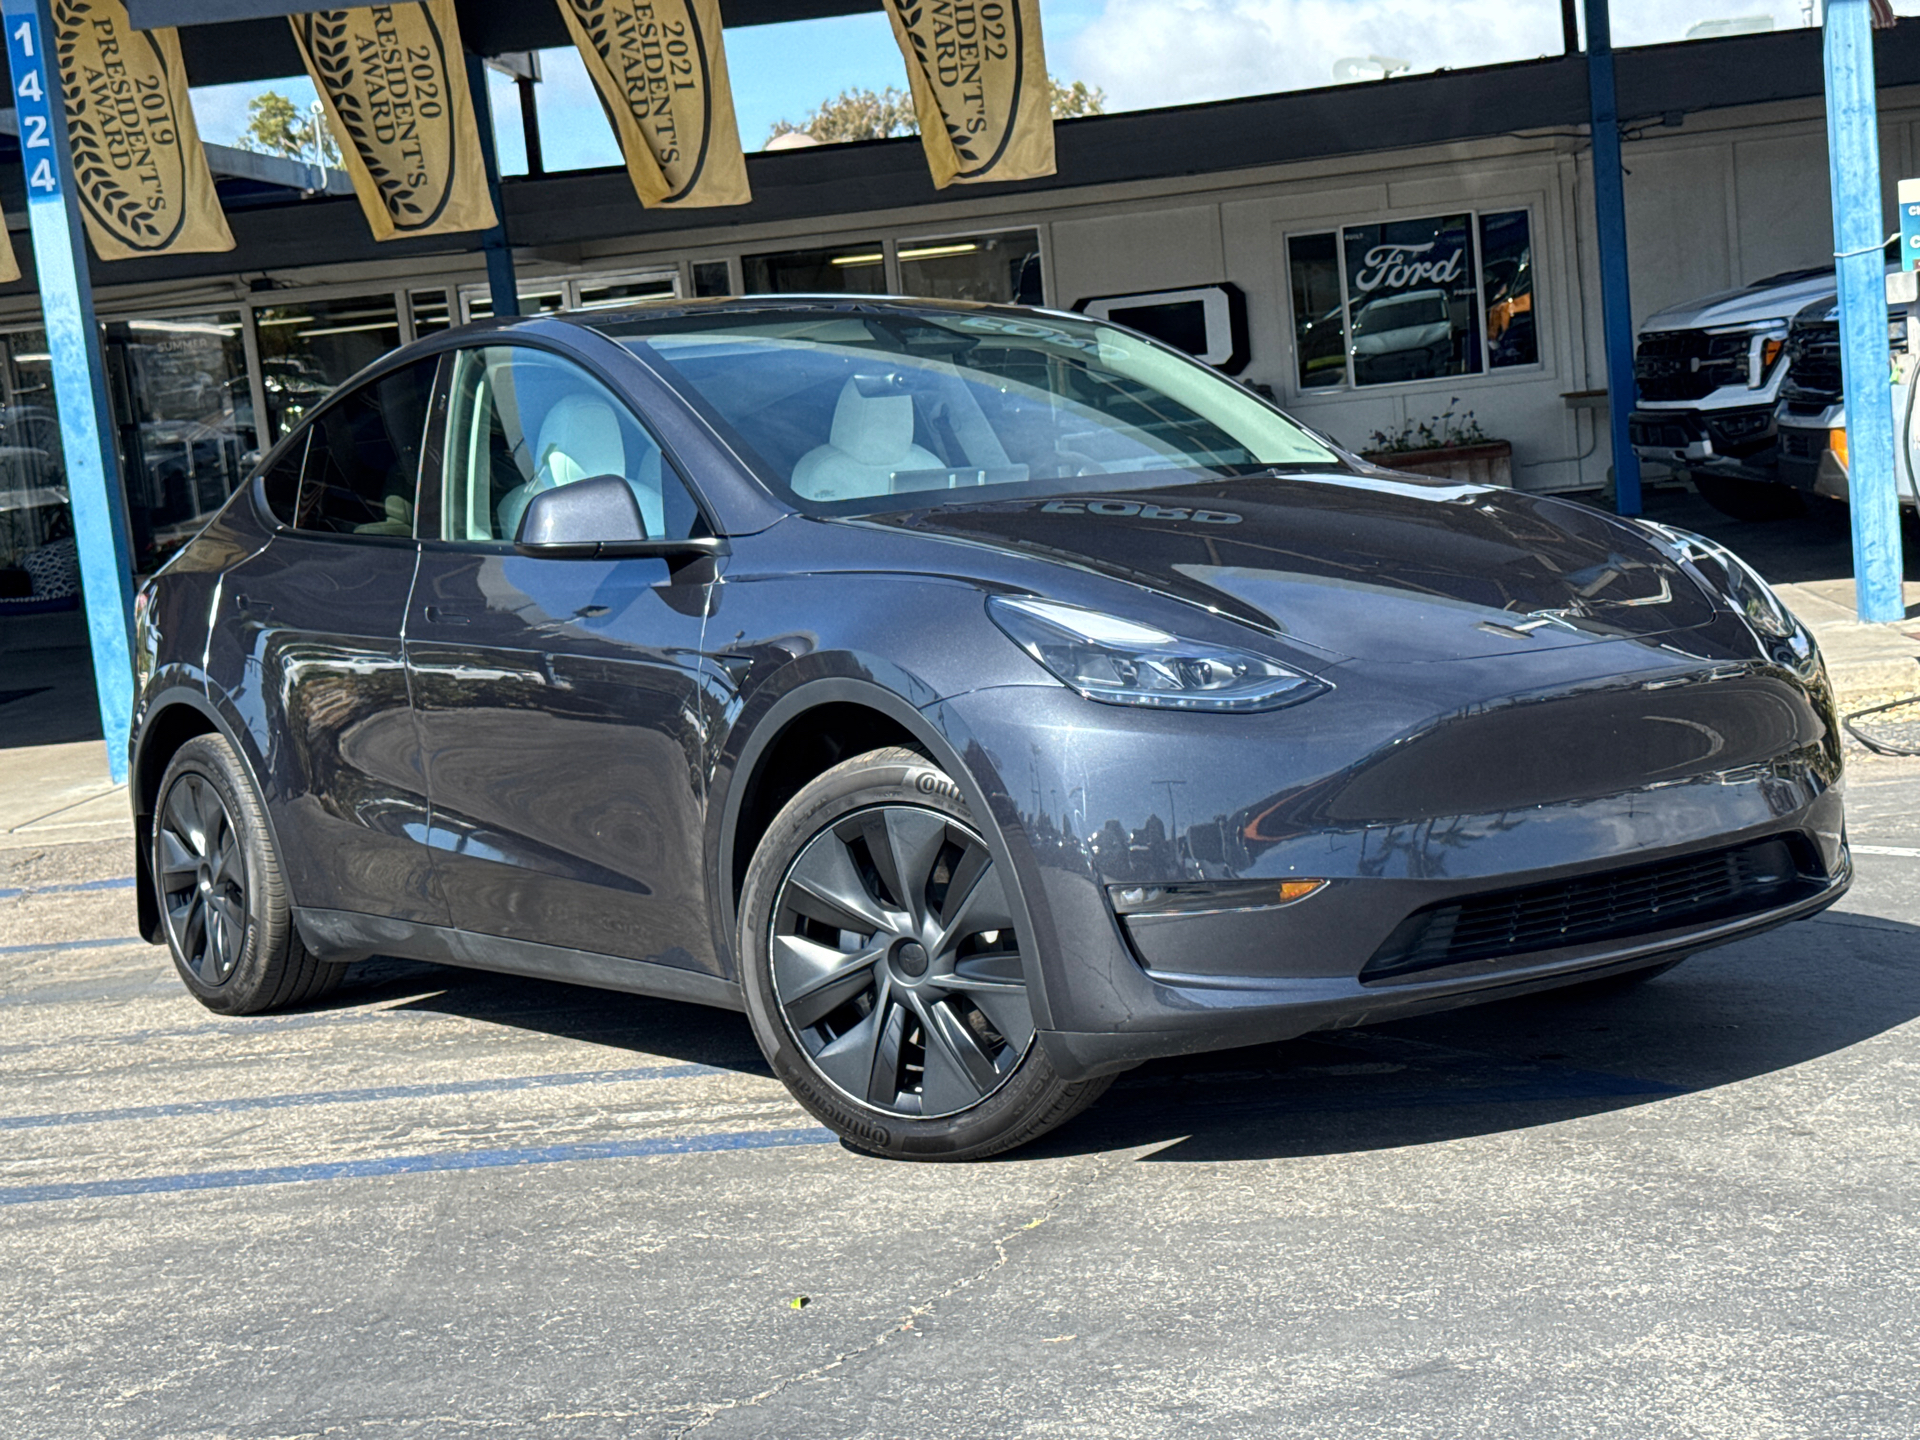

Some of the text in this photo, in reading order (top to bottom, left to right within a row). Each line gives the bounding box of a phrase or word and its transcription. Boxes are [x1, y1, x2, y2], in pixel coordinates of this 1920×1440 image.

[406, 45, 442, 119] 2020
[612, 6, 650, 120] AWARD
[632, 0, 680, 164] ESIDENT'S
[662, 20, 696, 92] 2021
[931, 0, 959, 87] WARD
[954, 0, 987, 134] IDENT'S
[980, 0, 1008, 61] 022
[14, 22, 55, 192] 1424
[84, 65, 132, 170] AWARD
[92, 16, 166, 211] PRESIDENT'S
[134, 75, 175, 146] 2019
[355, 34, 396, 145] AWARD
[371, 4, 428, 189] RESIDENT'S
[1355, 241, 1463, 292] Ford
